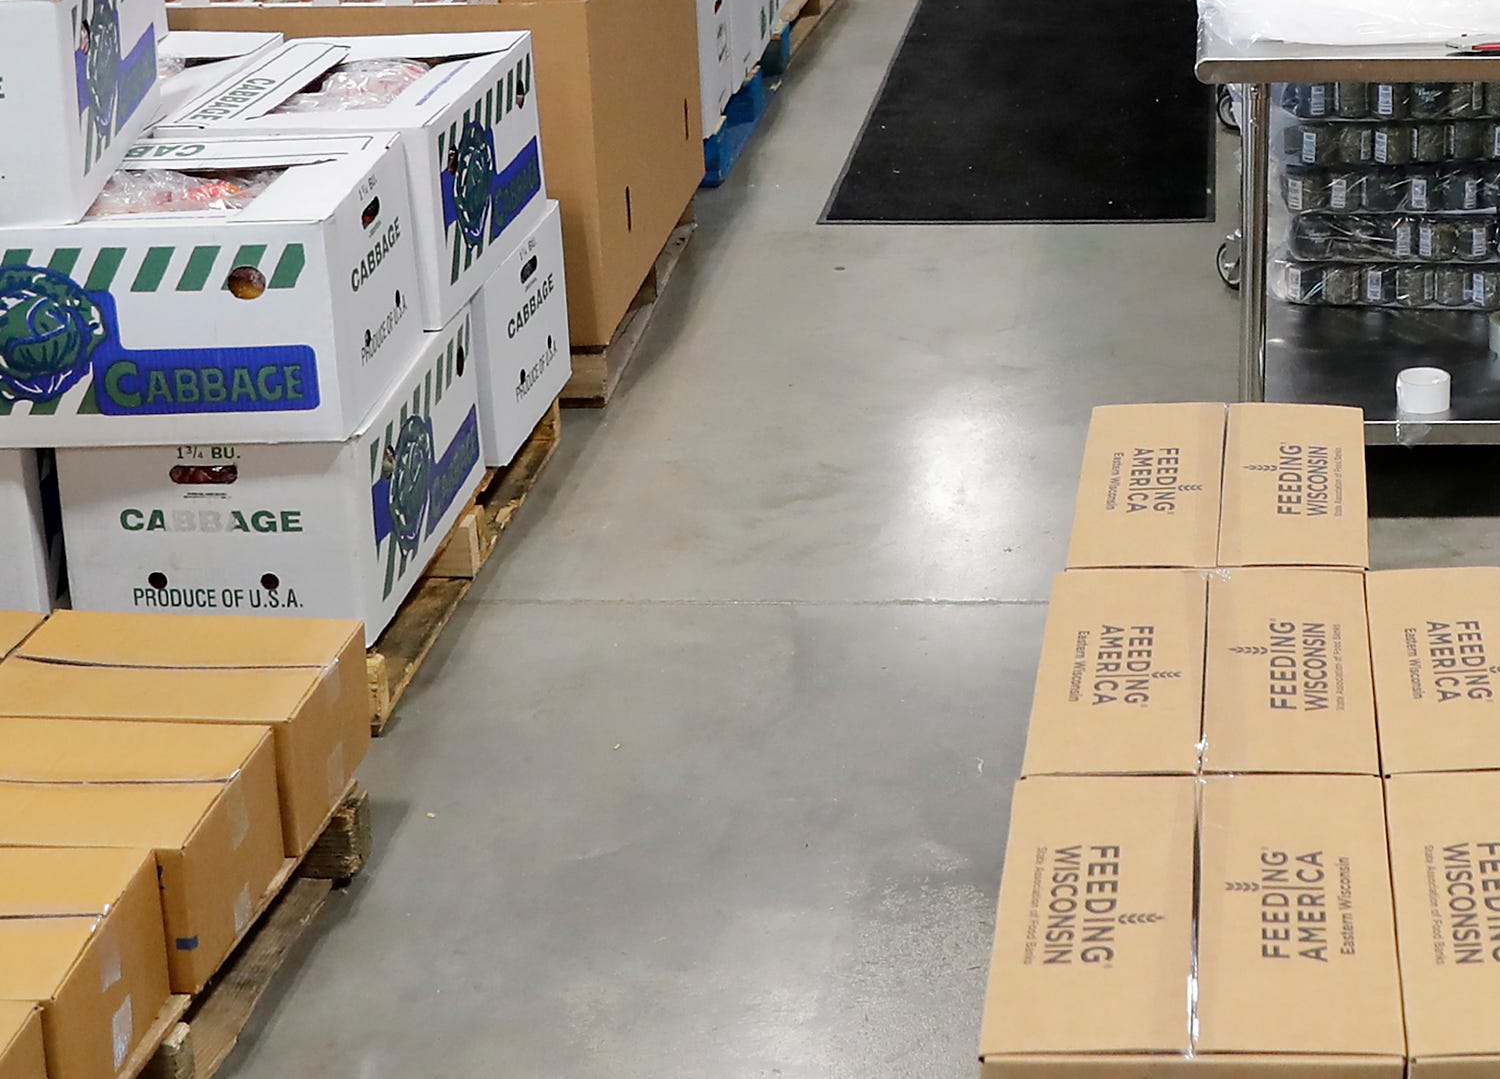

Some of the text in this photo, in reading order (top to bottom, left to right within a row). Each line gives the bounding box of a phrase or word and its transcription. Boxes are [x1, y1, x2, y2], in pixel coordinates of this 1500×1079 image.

[199, 77, 276, 123] CABBAGE
[351, 216, 401, 292] CABBAGE
[507, 273, 555, 339] CABBAGE
[104, 361, 304, 408] CABBAGE
[211, 446, 241, 459] BU.
[1126, 447, 1155, 513] AMERICA
[1153, 447, 1180, 513] FEEDING
[1277, 444, 1303, 516] FEEDING
[1306, 445, 1329, 517] WISCONSIN
[134, 588, 303, 608] PRODUCE OF U.S.A.
[1068, 630, 1090, 702] Eastern Wisconsin
[1092, 624, 1125, 706] AMERICA
[1124, 625, 1154, 706] FEEDING
[1269, 621, 1298, 711] FEEDING
[1302, 622, 1329, 711] WISCONSIN
[1404, 628, 1423, 700] Eastern Wisconsin
[1426, 620, 1462, 703] AMERICA
[1456, 620, 1494, 701] FEEDING
[1042, 844, 1083, 965] WISCONSIN
[1080, 844, 1120, 963] FEEDING
[1260, 849, 1291, 959] FEEDING
[1296, 850, 1328, 963] AMERICA
[1336, 856, 1356, 955] Eastern Wisconsin
[1442, 842, 1485, 965] WISCONSIN
